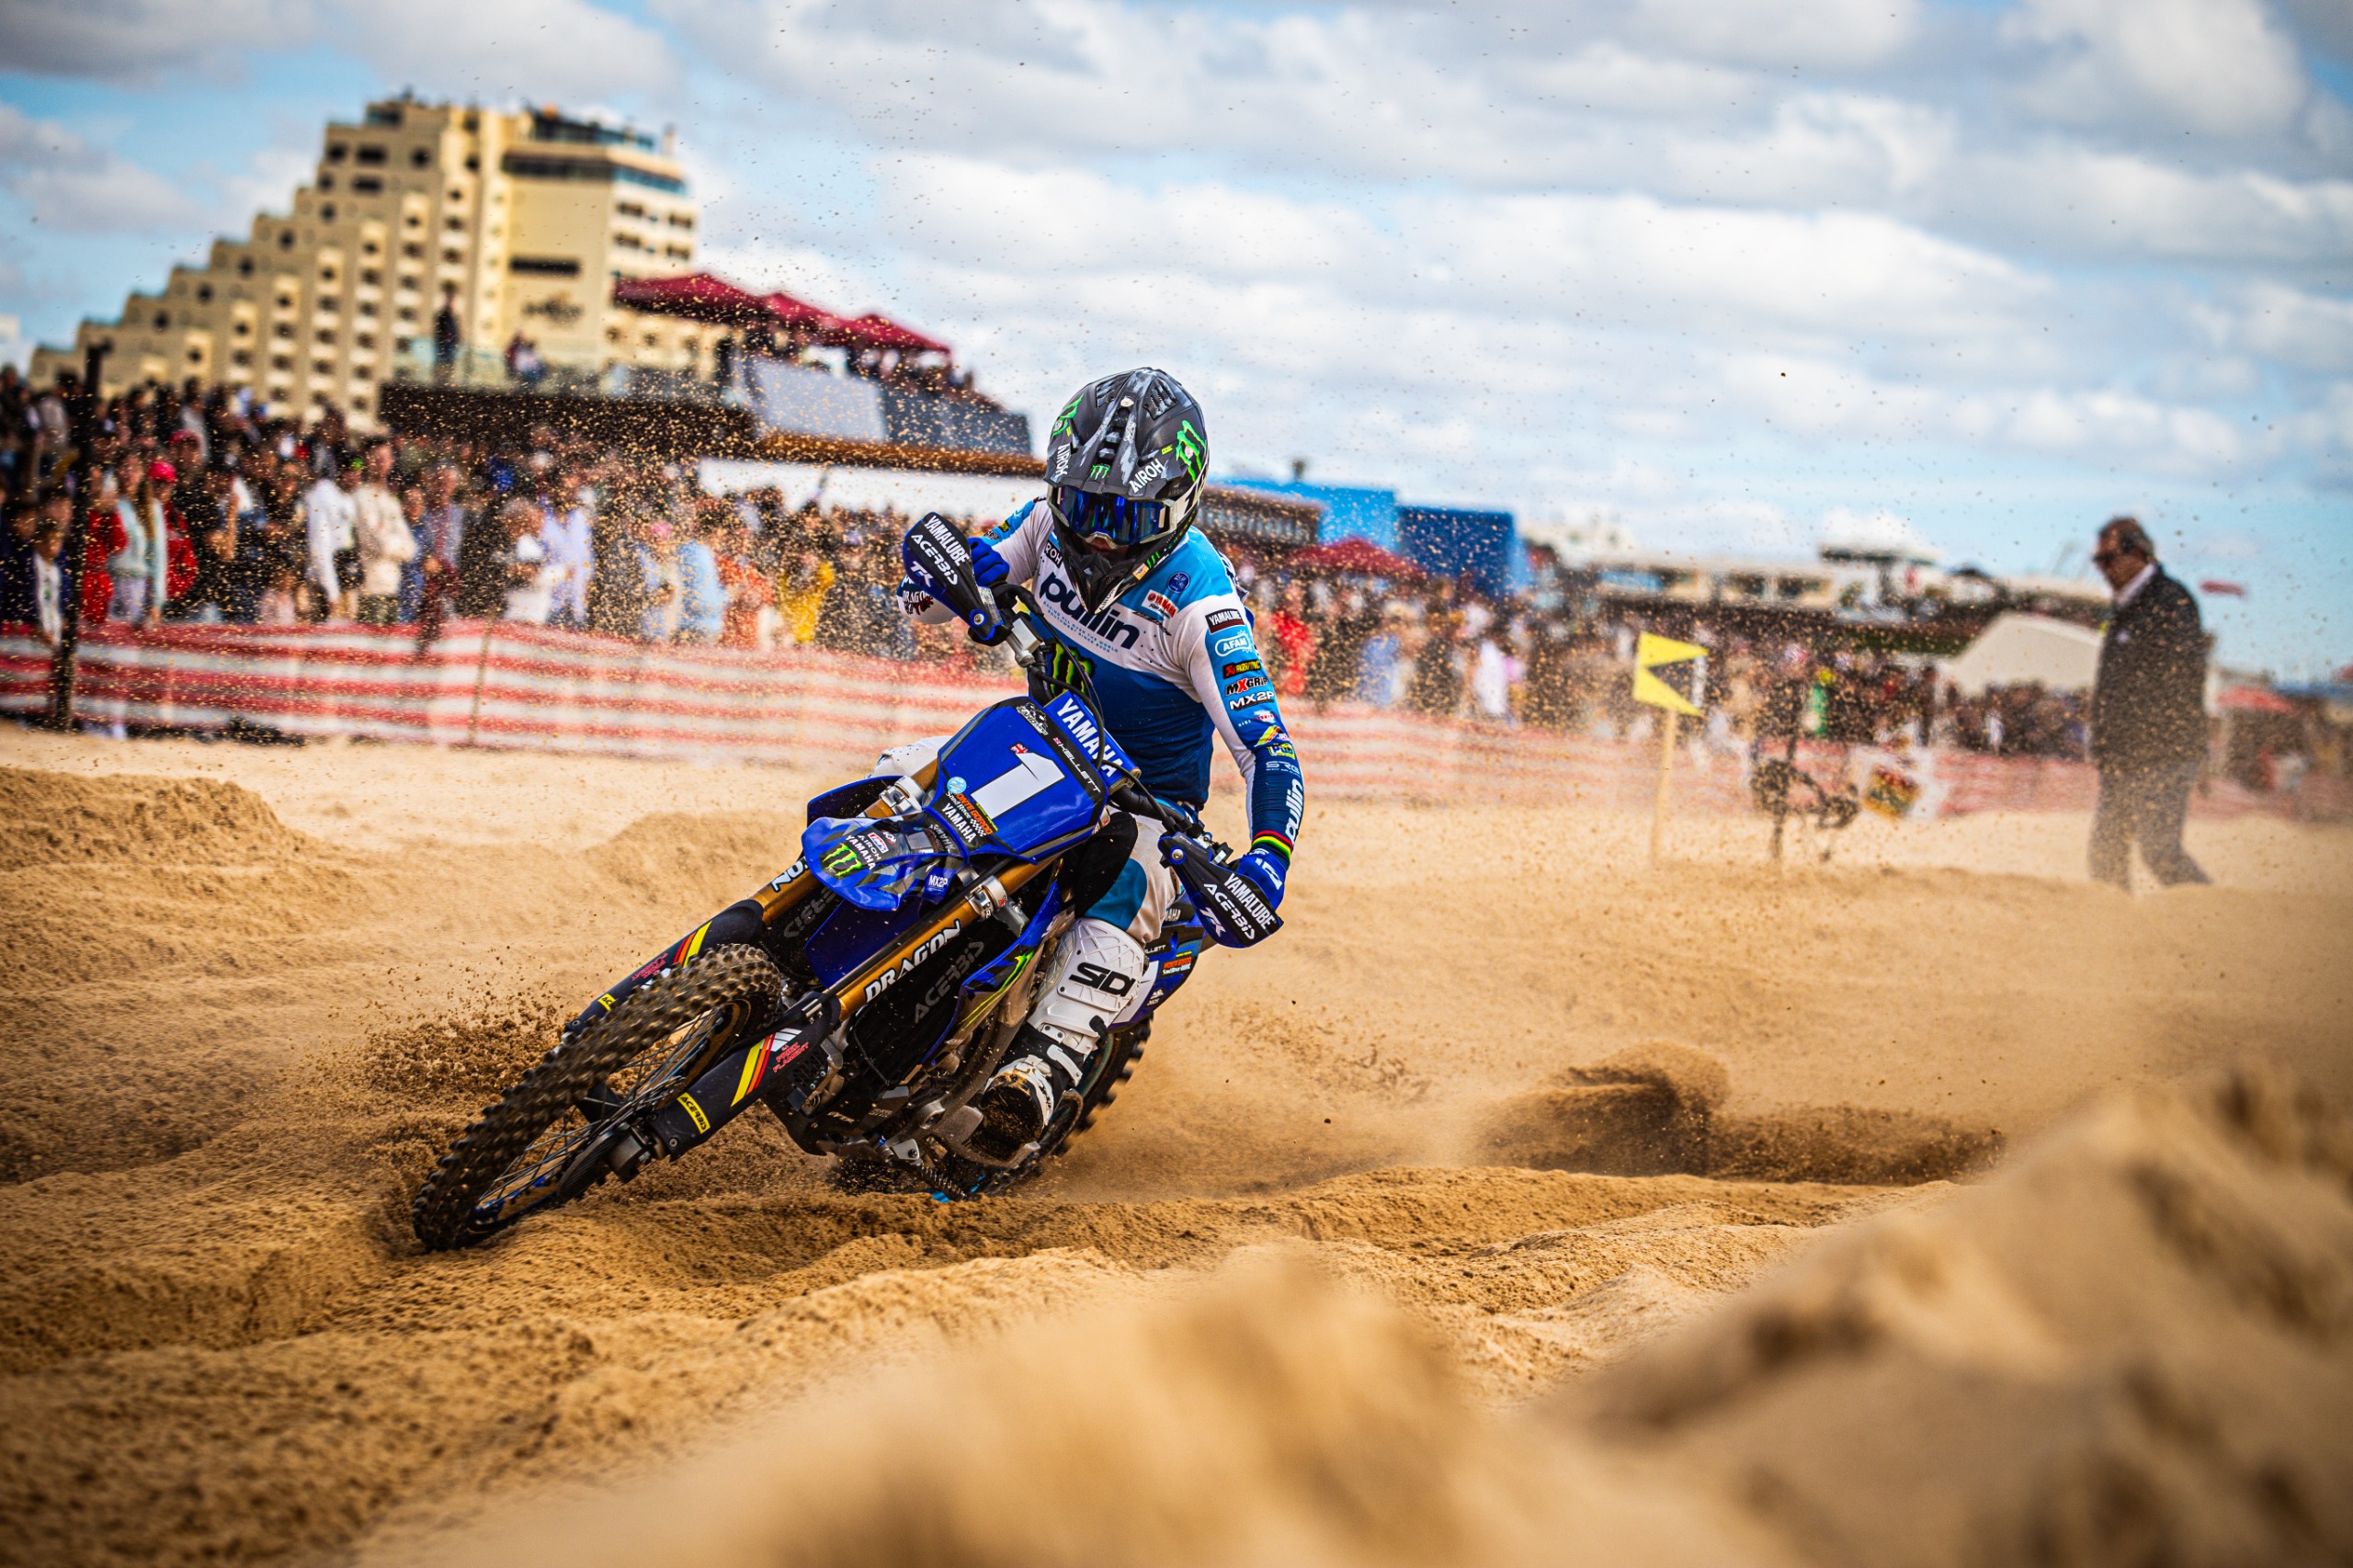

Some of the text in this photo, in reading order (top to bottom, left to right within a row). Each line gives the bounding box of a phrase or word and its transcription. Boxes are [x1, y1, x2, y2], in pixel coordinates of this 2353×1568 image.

[1129, 460, 1165, 493] AIROH
[925, 516, 970, 566] YAMALUBE
[1222, 637, 1247, 652] AFAM
[1230, 691, 1274, 710] MX2P
[971, 753, 1065, 819] 1
[1058, 744, 1101, 792] KELLETT
[942, 802, 976, 843] YAMAHA
[956, 793, 975, 811] ONTE
[971, 810, 993, 835] GORDO
[1285, 778, 1303, 846] pullin
[846, 835, 876, 869] YAMAHA
[858, 835, 881, 860] AIROH
[928, 875, 948, 888] MX2P
[1223, 873, 1275, 929] YAMALUBE
